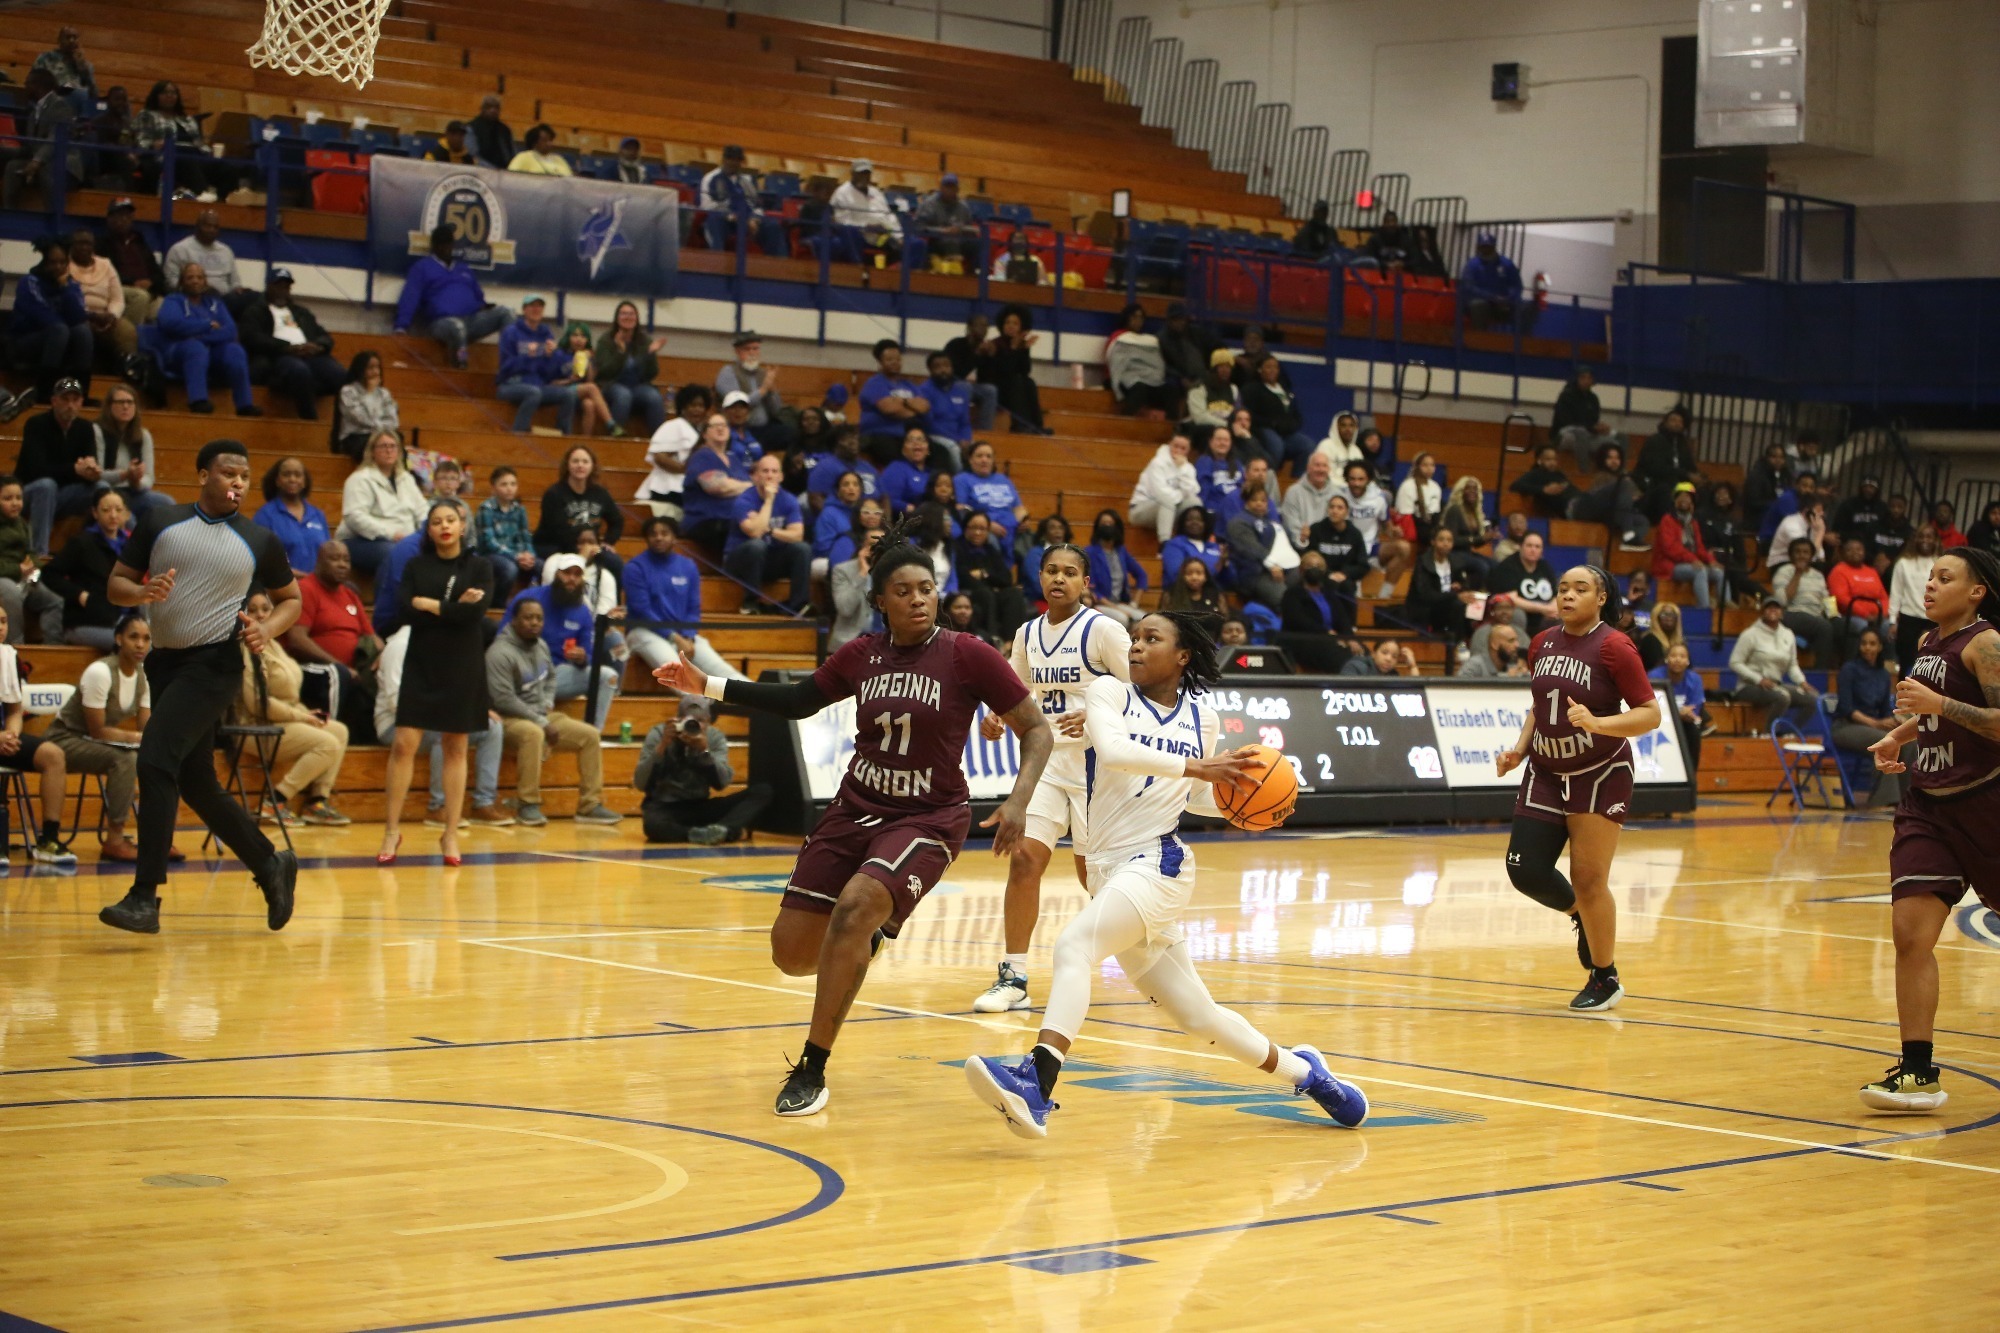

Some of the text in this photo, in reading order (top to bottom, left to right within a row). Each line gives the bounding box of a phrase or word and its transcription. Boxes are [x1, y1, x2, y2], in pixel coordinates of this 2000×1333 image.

[445, 203, 485, 243] 50
[1061, 647, 1078, 655] CIAA
[1030, 666, 1081, 684] IKINGS
[1532, 655, 1592, 691] VIRGINIA
[30, 692, 63, 707] ECSU
[861, 672, 941, 712] VIRGINIA
[1042, 689, 1066, 715] 20
[1436, 708, 1495, 728] Elizabeth
[1546, 688, 1560, 726] 1
[874, 711, 912, 756] 11
[1533, 728, 1594, 759] UNION
[1316, 753, 1335, 780] 2
[1453, 746, 1490, 765] Home
[853, 754, 933, 797] UNION
